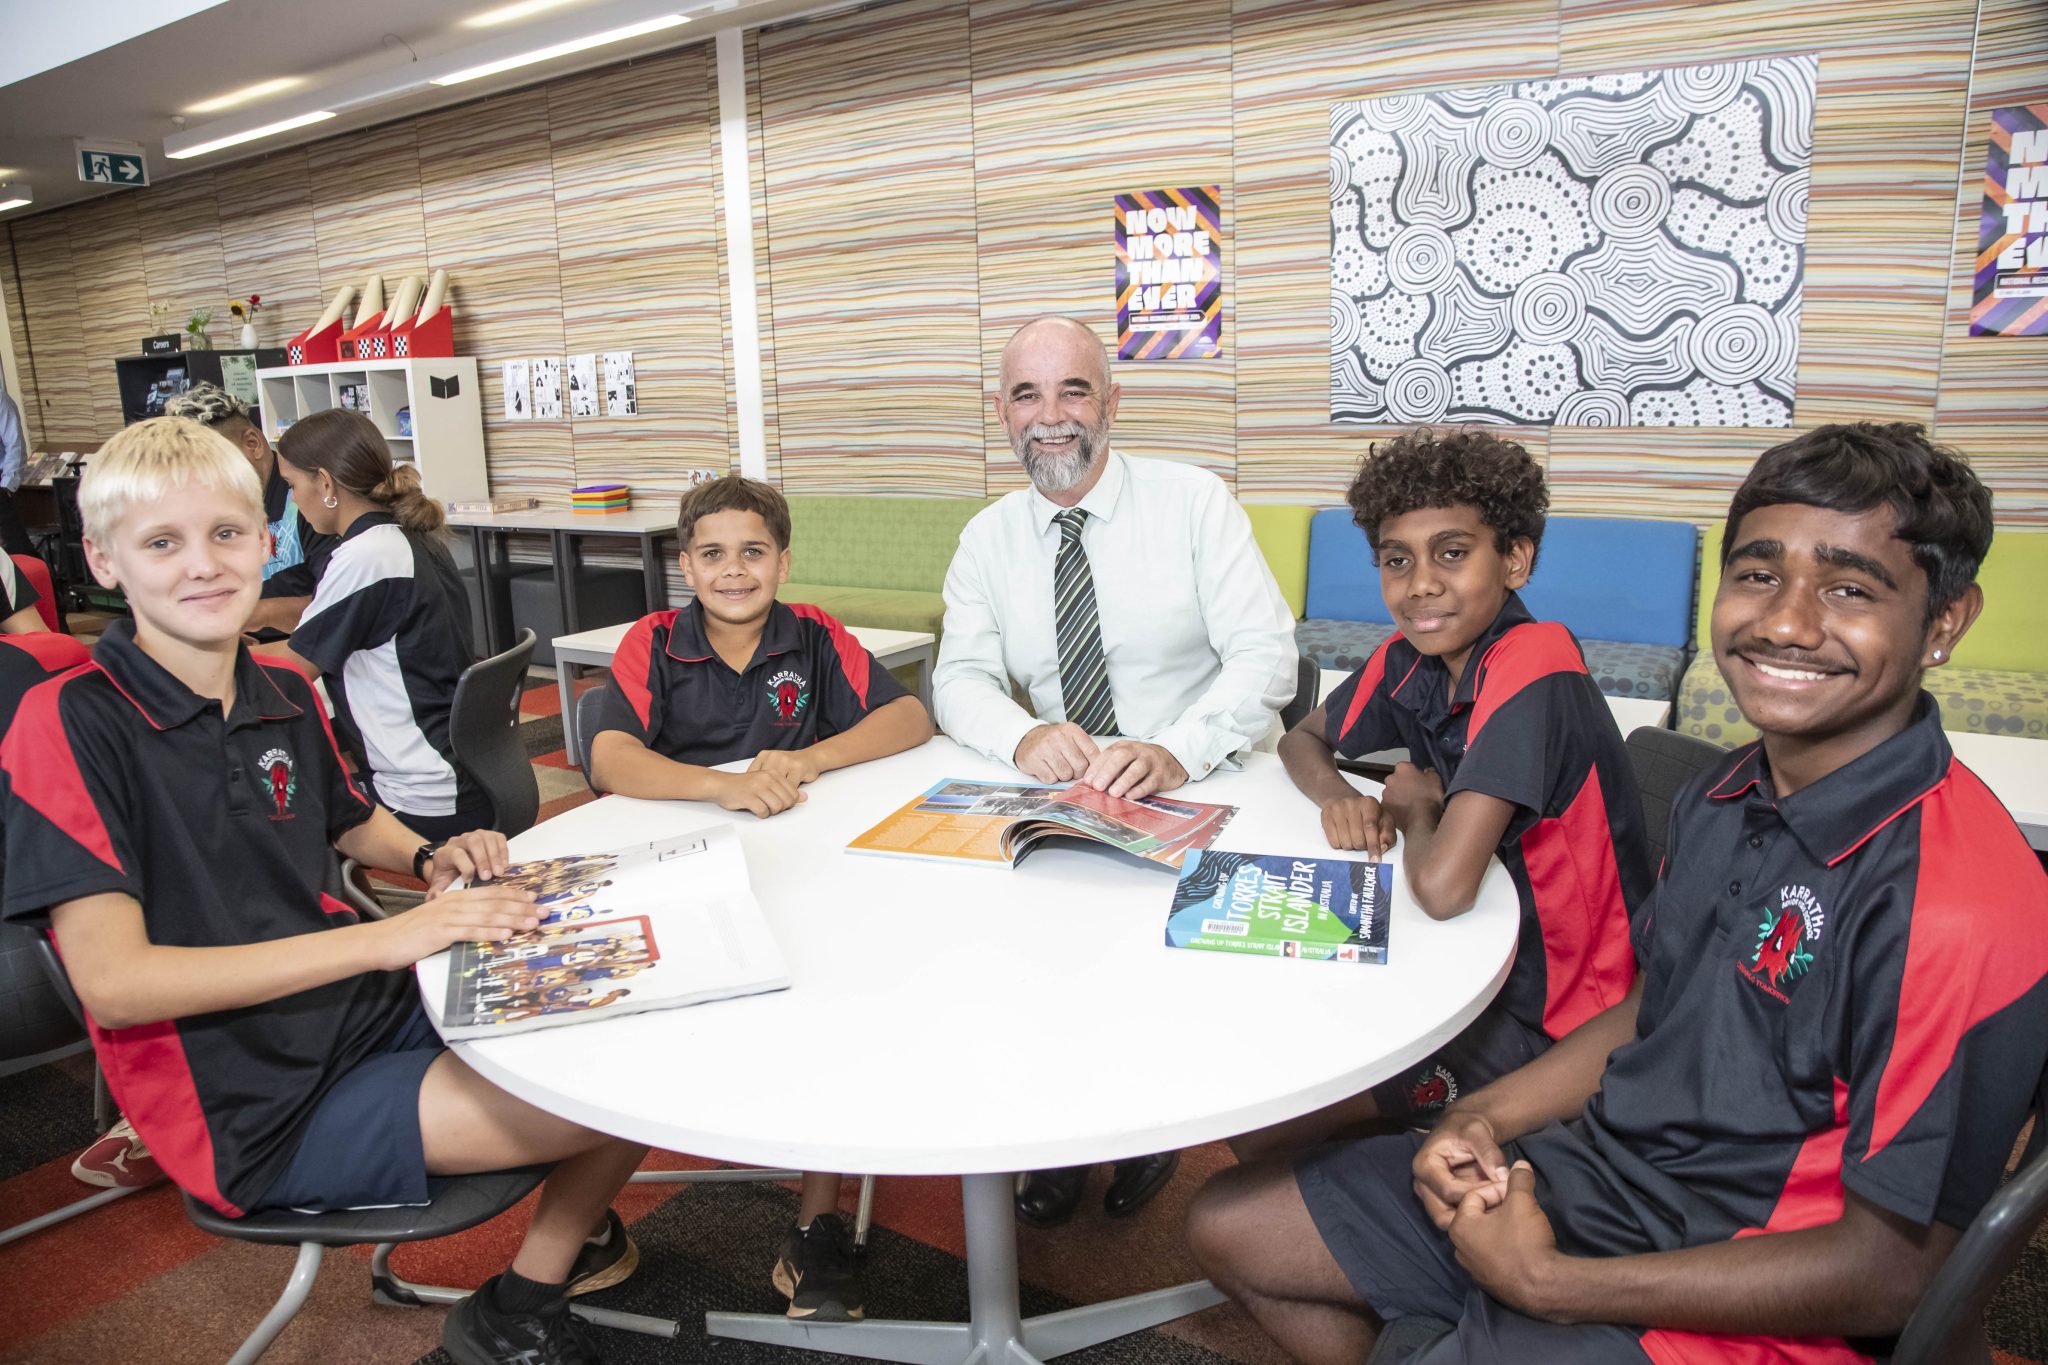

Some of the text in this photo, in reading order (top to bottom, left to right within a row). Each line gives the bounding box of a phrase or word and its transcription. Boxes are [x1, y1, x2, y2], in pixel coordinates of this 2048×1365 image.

[1125, 205, 1197, 234] NOW
[2002, 201, 2048, 234] TH
[1126, 230, 1210, 260] MORE
[1996, 236, 2048, 269] EV
[1126, 257, 1204, 285] THAN
[1127, 284, 1197, 311] EVER
[152, 340, 170, 350] Careers
[766, 670, 807, 688] KARRATHA
[1226, 865, 1263, 921] TORRES
[1257, 870, 1288, 921] STRAIT
[1281, 860, 1317, 935] ISLANDER
[1318, 880, 1333, 913] AUSTRALIA
[1361, 866, 1377, 904] FAULKNER
[1359, 904, 1375, 940] SAMANTHA
